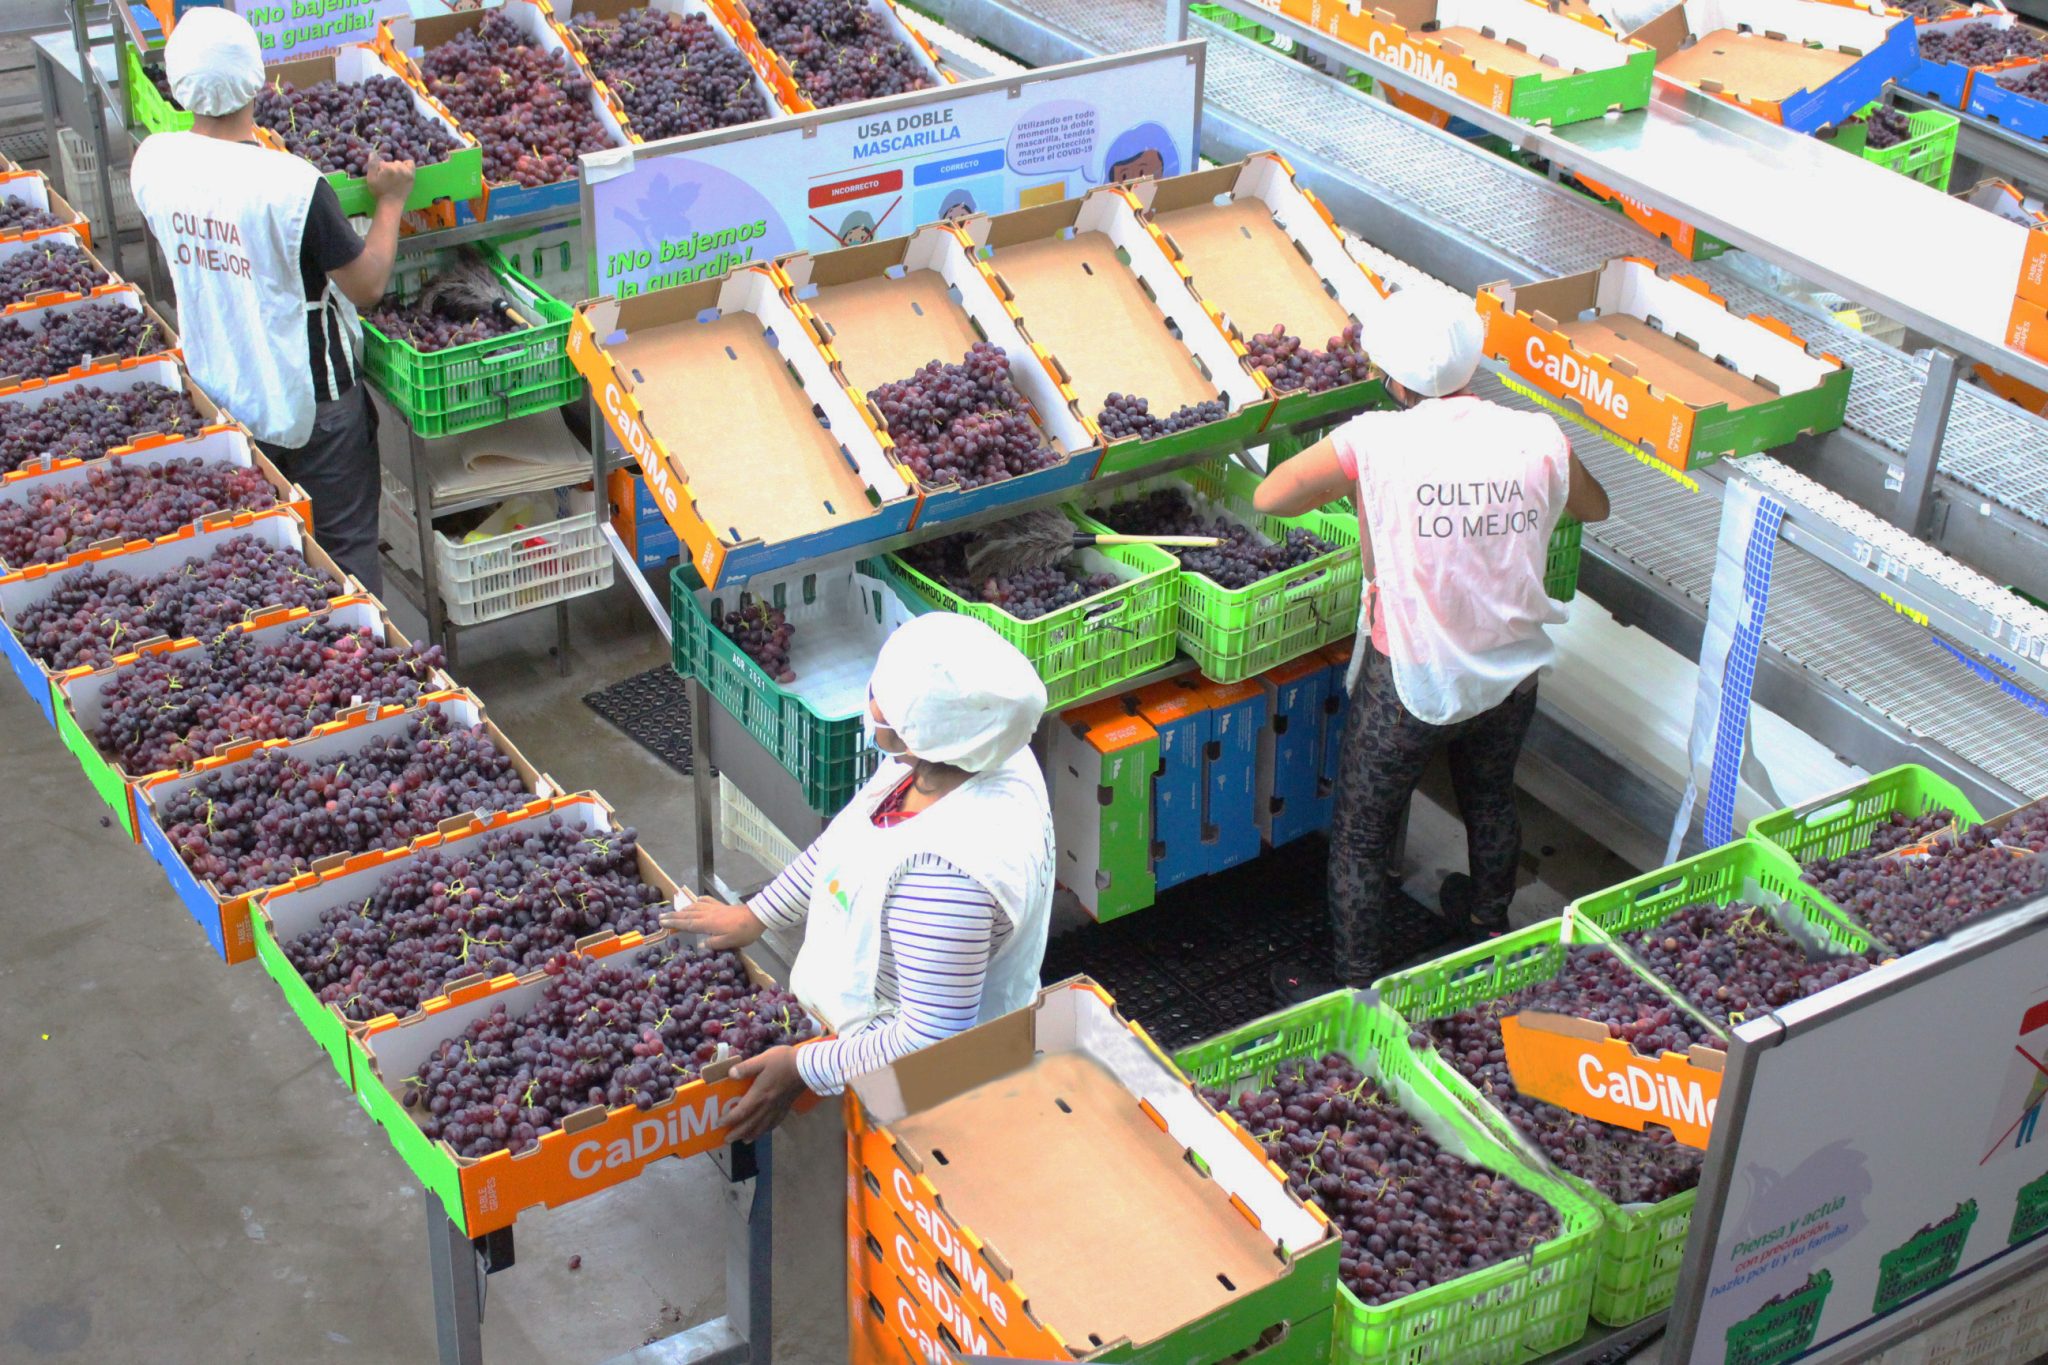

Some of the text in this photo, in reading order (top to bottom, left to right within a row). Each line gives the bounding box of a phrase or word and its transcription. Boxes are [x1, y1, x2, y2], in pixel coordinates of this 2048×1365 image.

[291, 0, 383, 19] bajem
[282, 9, 375, 49] guardia!
[858, 108, 953, 140] USA DOBLE
[1017, 116, 1061, 131] Utilizando
[1075, 110, 1095, 120] todo
[1018, 119, 1094, 140] momento la doble
[1063, 128, 1095, 139] tendrás
[853, 125, 961, 159] MASCARILLA
[1017, 145, 1093, 166] contra el COVID-19
[1018, 137, 1092, 158] mayor protección
[940, 159, 979, 173] CORRECTO
[831, 180, 880, 196] INCORRECTO
[172, 212, 241, 246] CULTIVA
[173, 243, 252, 280] O MEJOR
[607, 219, 767, 278] ¡No bajemos
[616, 279, 639, 300] la
[1525, 335, 1630, 420] CaDiMe
[605, 383, 678, 513] CaDiMe
[1417, 479, 1524, 506] CULTIVA
[1418, 509, 1538, 538] LO MEJOR
[1730, 1196, 1846, 1262] Piensa y actúa
[893, 1168, 1008, 1328] CaDiMe
[1710, 1275, 1745, 1298] hazlo
[1746, 1263, 1770, 1284] por
[1780, 1254, 1791, 1266] y
[1807, 1223, 1849, 1251] familia
[1734, 1255, 1759, 1274] con
[896, 1234, 988, 1356] CaDiM
